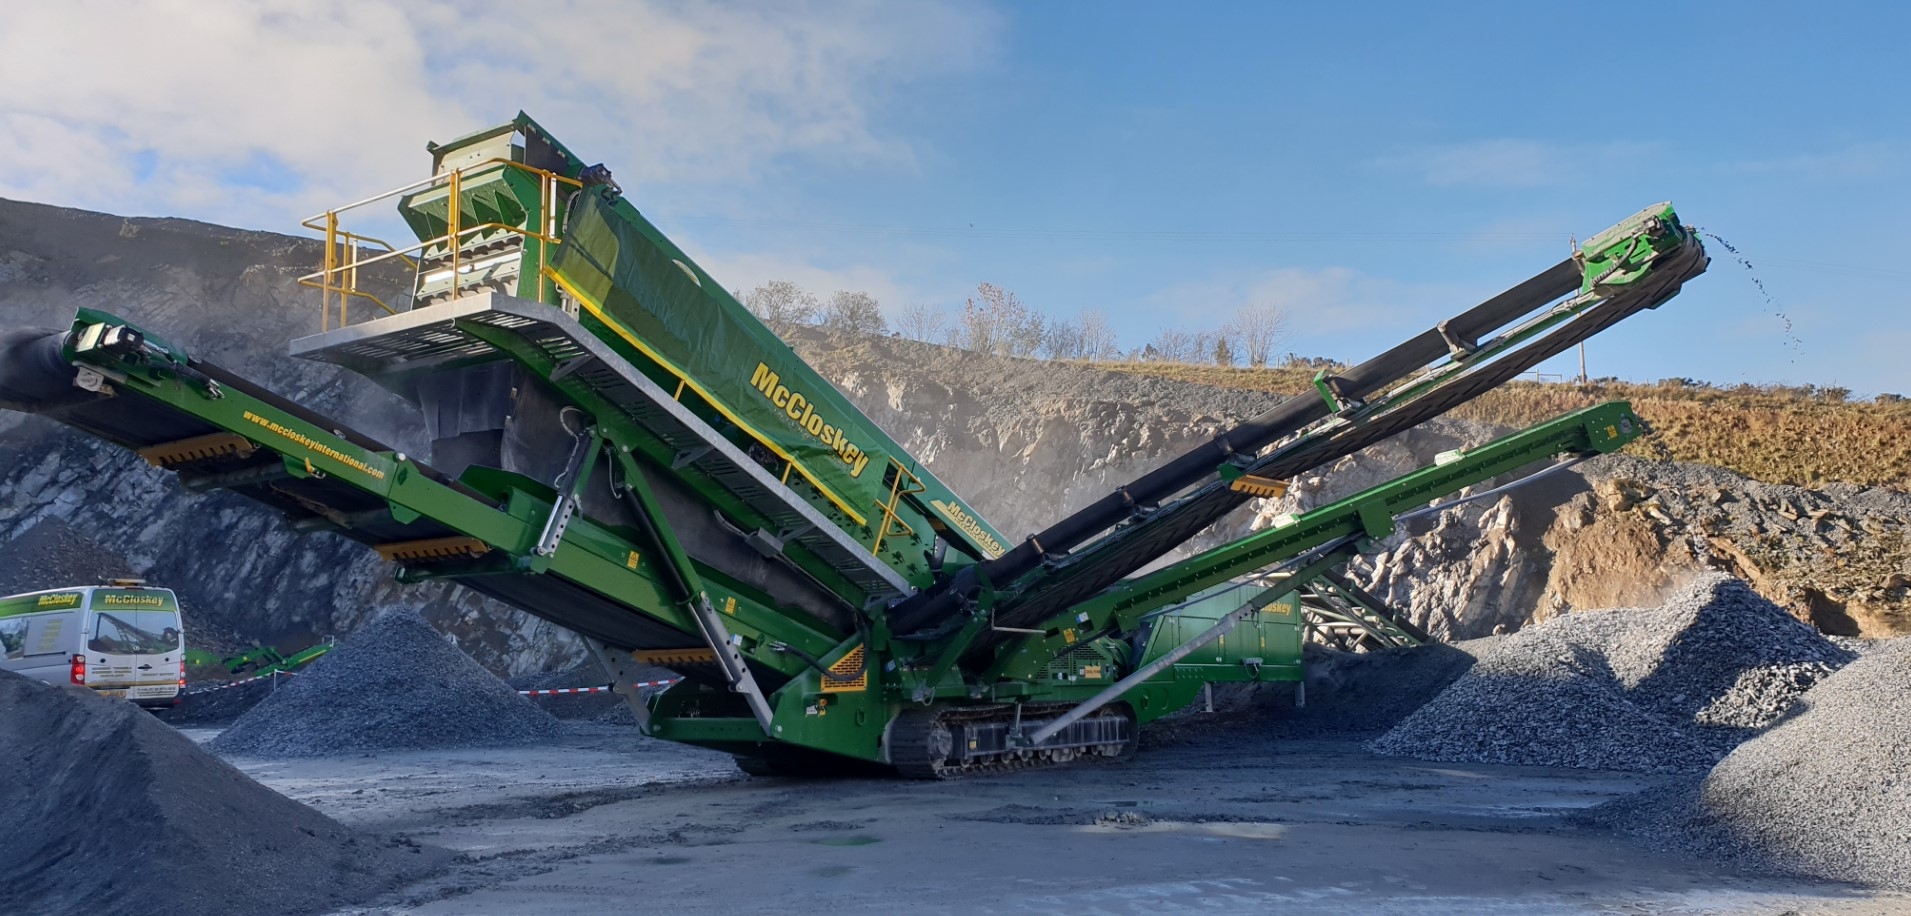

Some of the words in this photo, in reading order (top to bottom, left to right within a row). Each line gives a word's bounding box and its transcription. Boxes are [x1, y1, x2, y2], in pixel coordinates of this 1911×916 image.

[243, 410, 385, 480] www.mccloskeyinternational.com
[750, 361, 869, 479] McCloskey
[947, 500, 1006, 557] McCloskey
[105, 594, 164, 607] McCloskey
